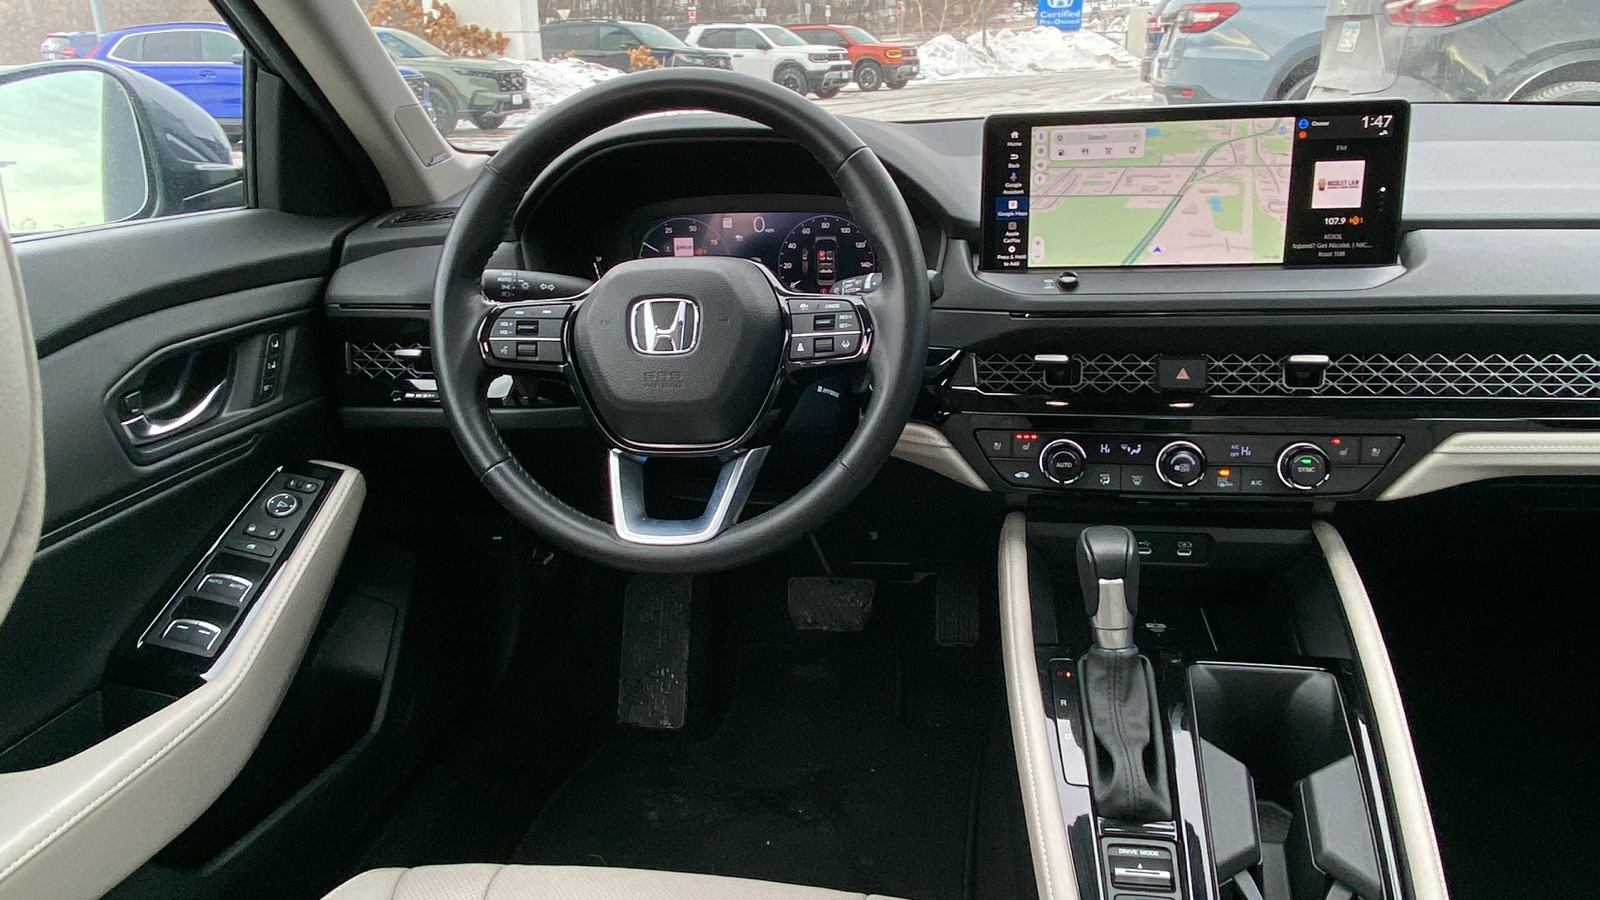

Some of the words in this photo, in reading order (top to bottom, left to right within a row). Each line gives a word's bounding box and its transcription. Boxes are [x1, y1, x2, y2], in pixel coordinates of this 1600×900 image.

[1040, 10, 1080, 18] Certified
[1361, 114, 1393, 128] 1:47
[753, 216, 765, 233] 0
[1324, 217, 1347, 225] 107.9
[801, 227, 811, 235] 60
[229, 582, 246, 590] AUTO
